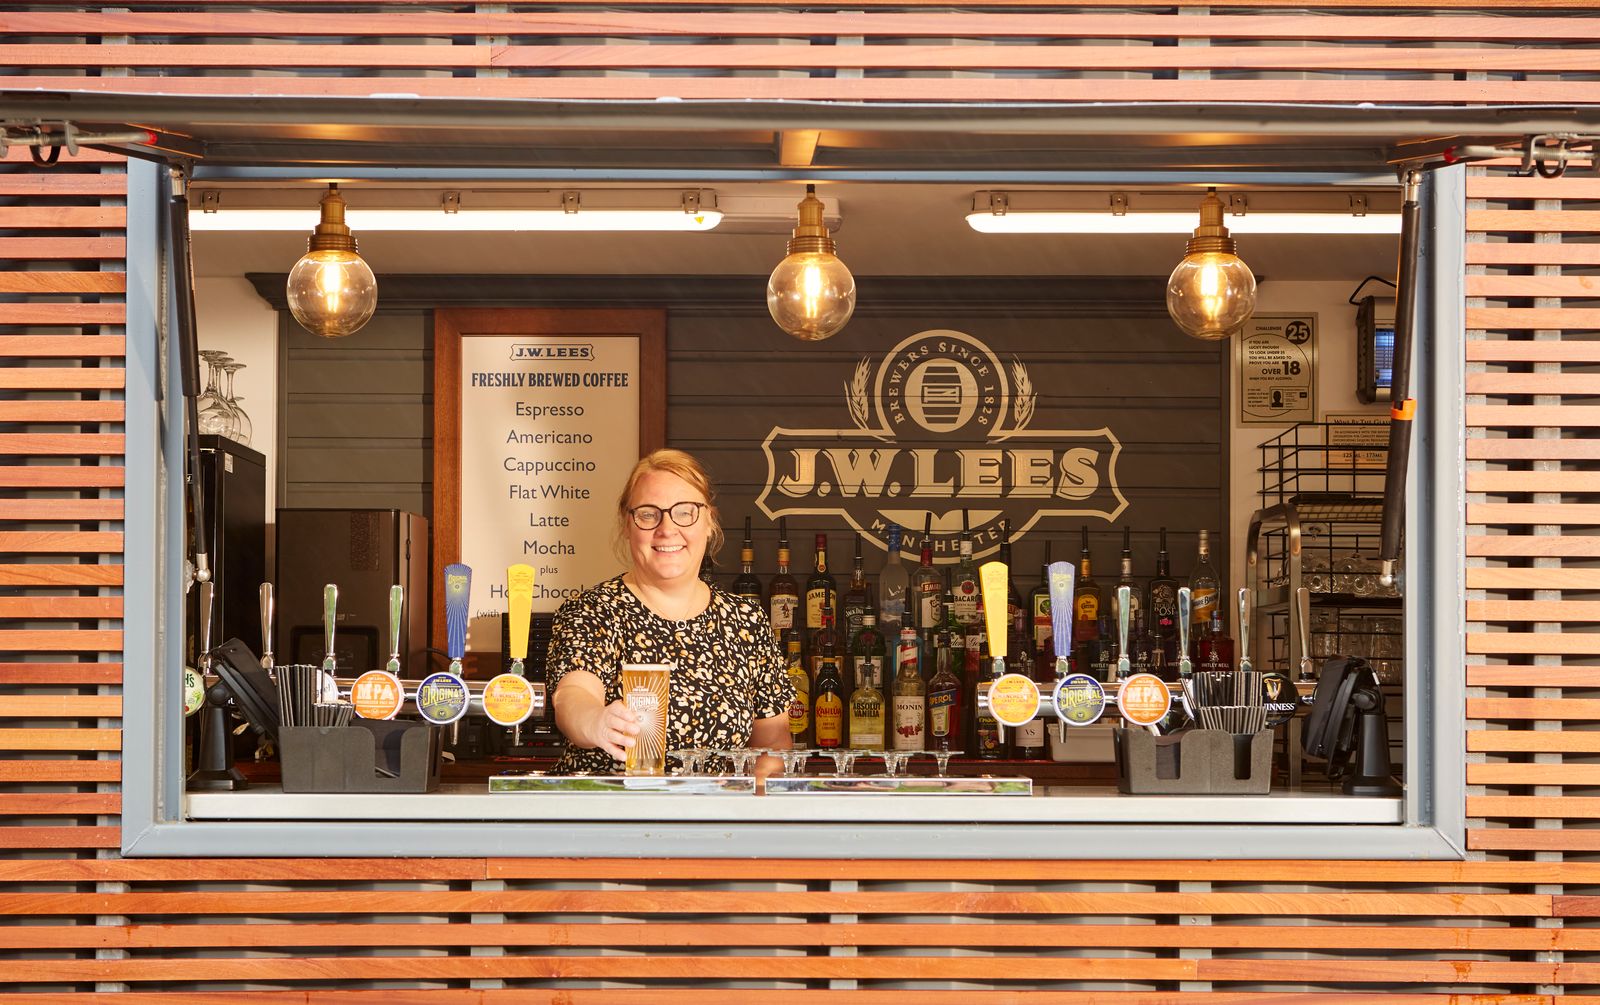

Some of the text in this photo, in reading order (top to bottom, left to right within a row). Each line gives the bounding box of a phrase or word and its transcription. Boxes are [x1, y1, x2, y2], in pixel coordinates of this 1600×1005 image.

[1287, 325, 1309, 340] 25
[1282, 361, 1300, 375] 18
[472, 372, 628, 387] FRESHLY BREWED COFFEE
[888, 341, 995, 425] BREWERS SINCE 1828
[516, 402, 584, 420] Espresso
[506, 430, 592, 444] Americano
[503, 457, 596, 475] Cappuccino
[509, 484, 590, 499] Flat White
[530, 512, 570, 527] Latte
[524, 540, 576, 554] Mocha
[540, 565, 558, 576] plus
[476, 608, 500, 620] (with
[356, 684, 394, 700] MPA
[422, 686, 464, 706] ORIGINAL
[1061, 688, 1102, 708] ORIGINAL
[1127, 686, 1164, 702] MPA
